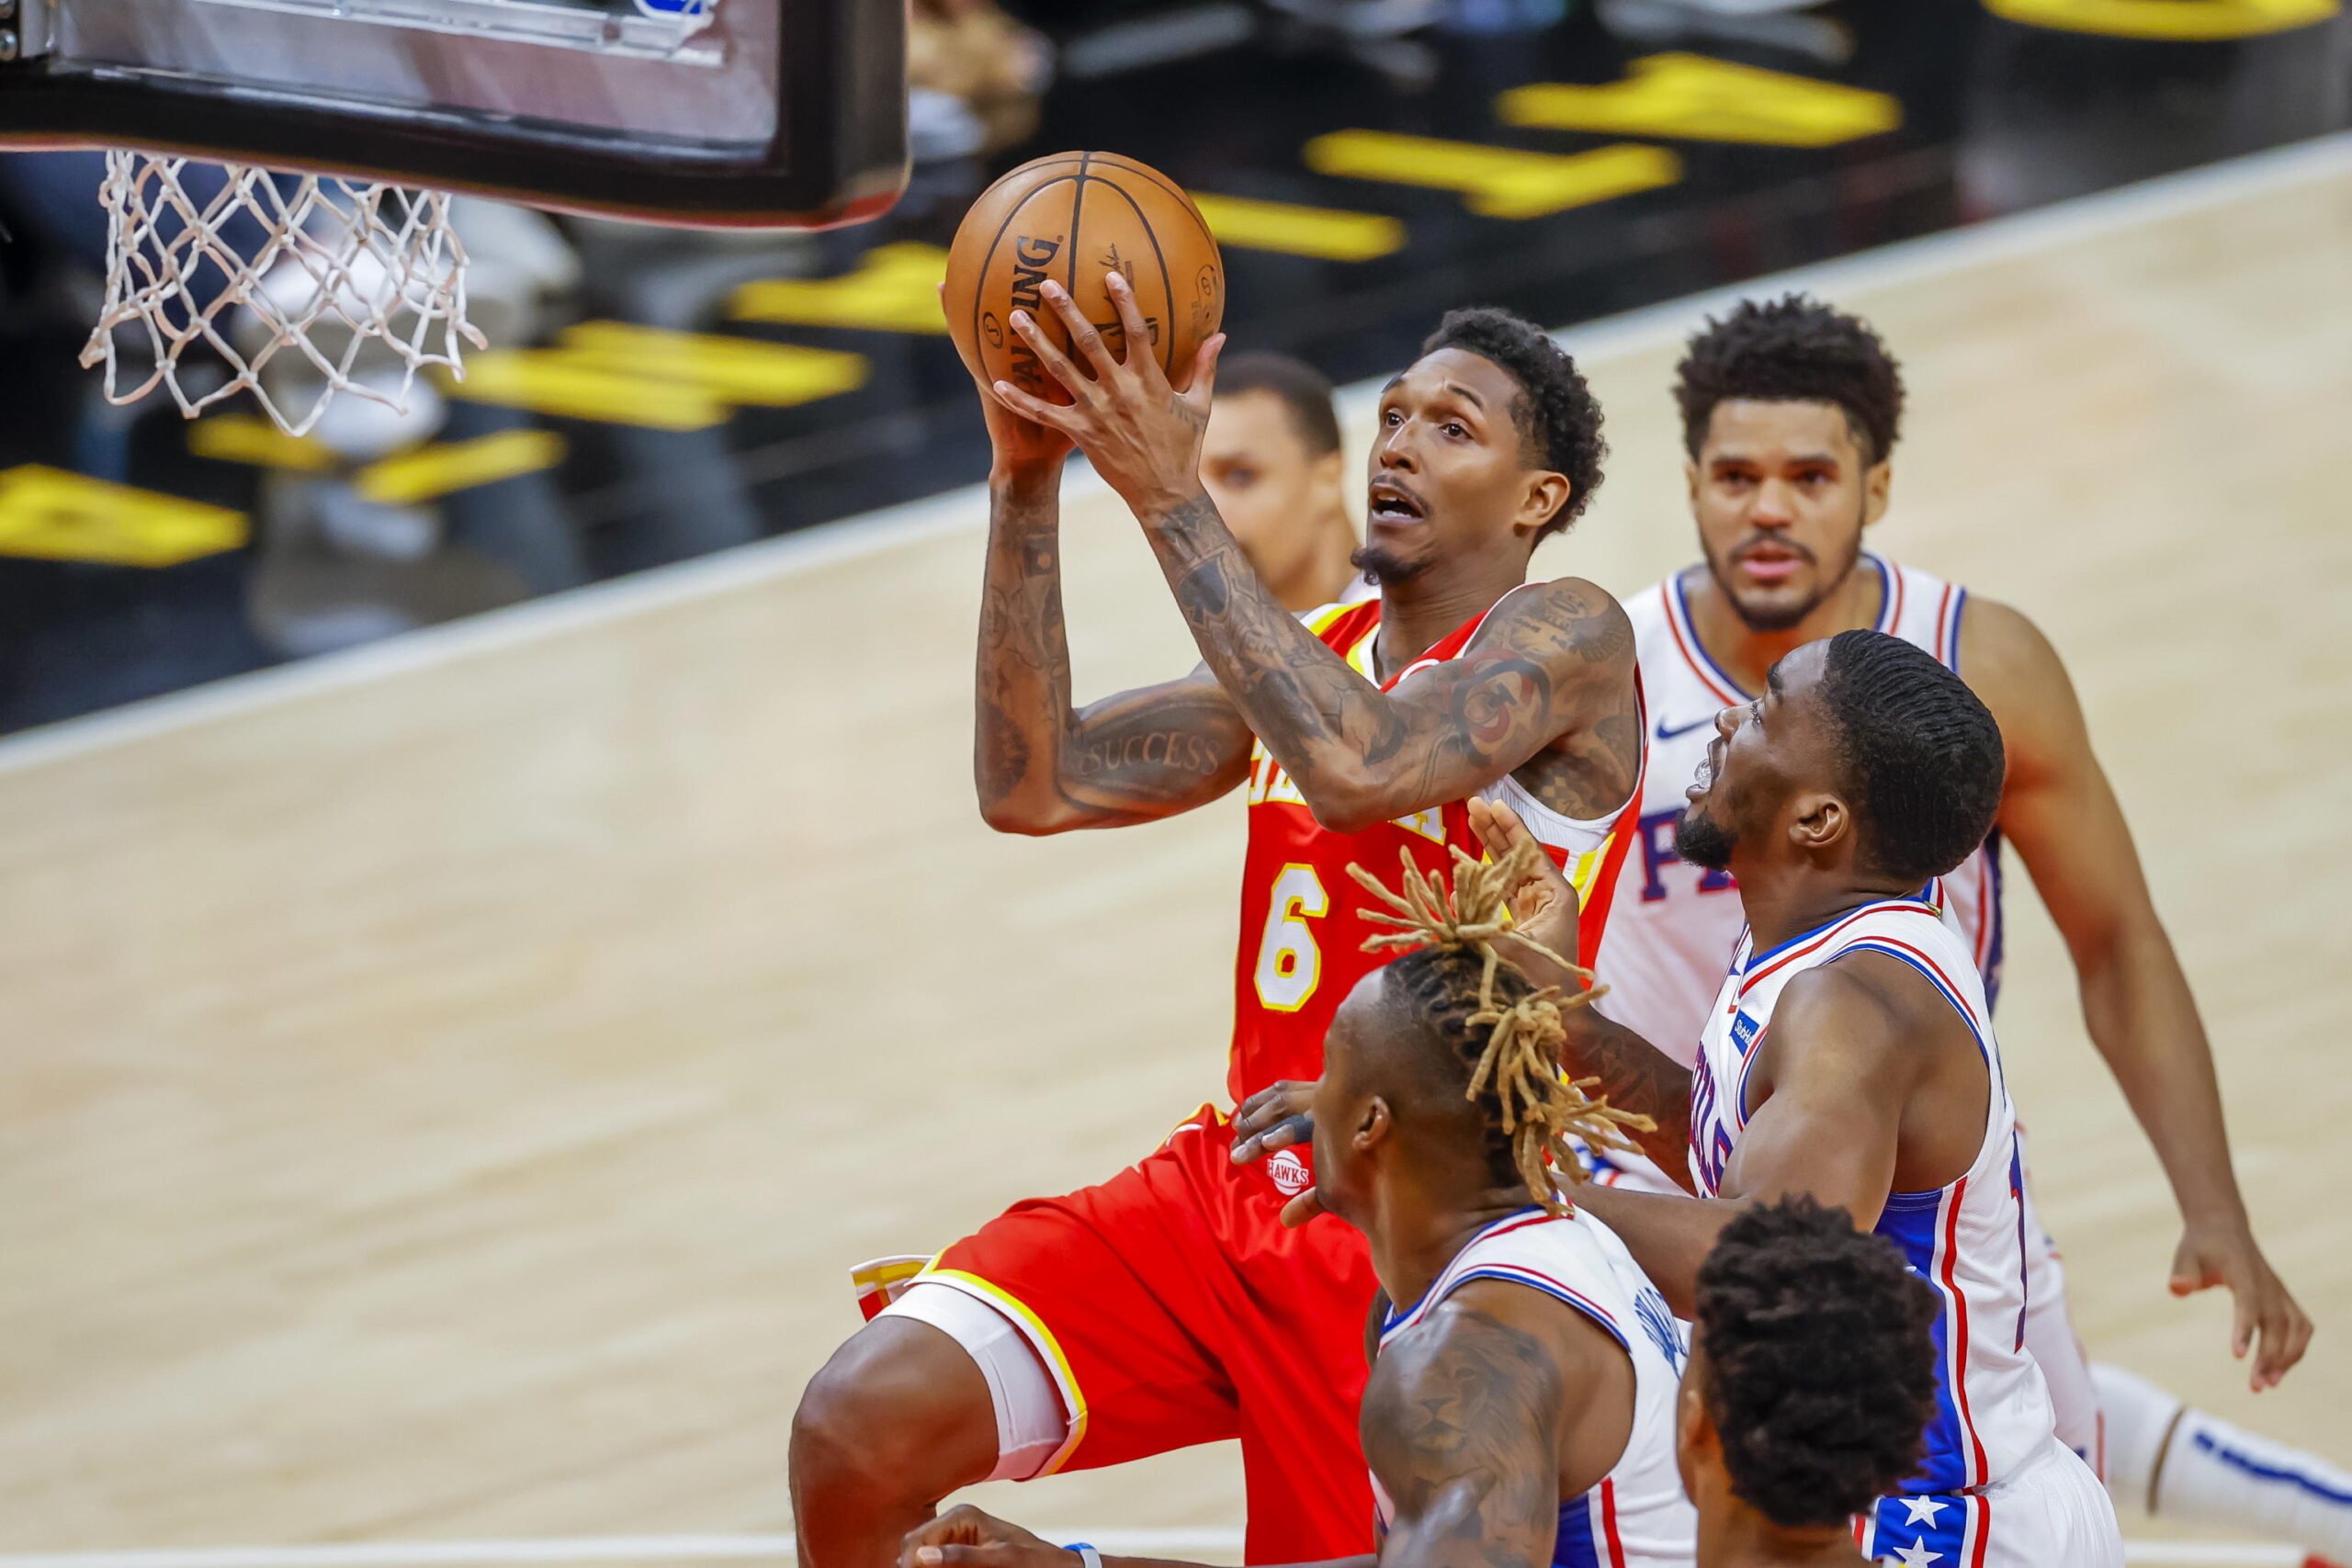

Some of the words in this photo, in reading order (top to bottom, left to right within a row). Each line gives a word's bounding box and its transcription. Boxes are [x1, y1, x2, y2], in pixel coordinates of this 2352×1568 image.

[1080, 732, 1221, 775] SUCCESS
[1254, 863, 1329, 1011] 6
[1267, 1159, 1309, 1186] HAWKS
